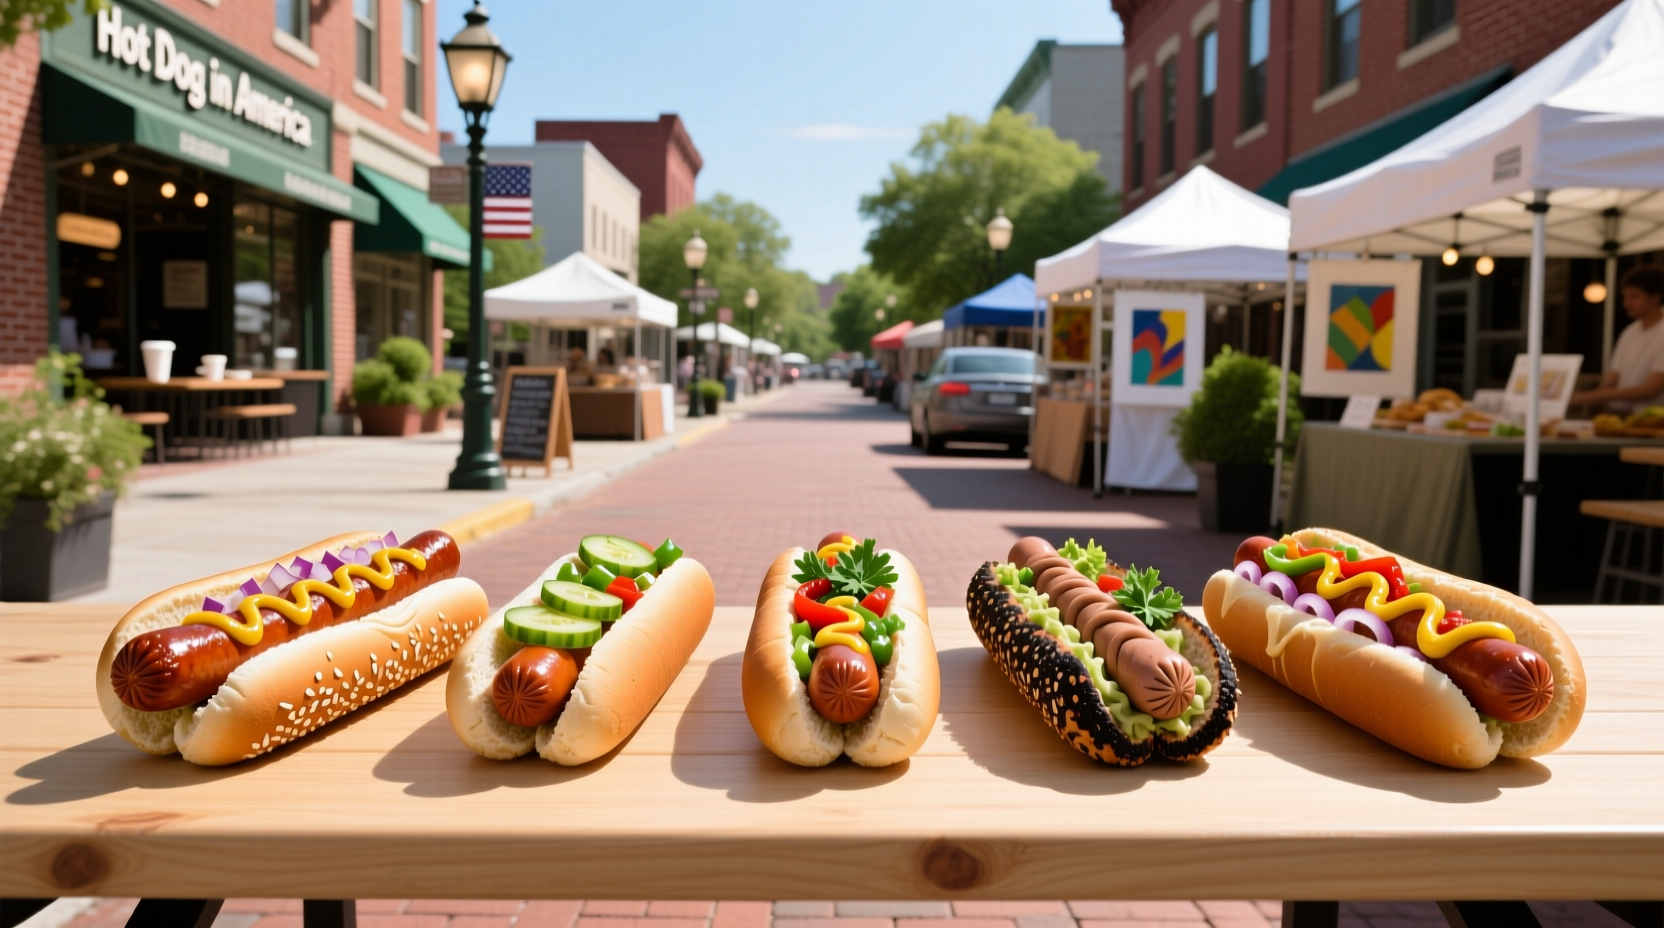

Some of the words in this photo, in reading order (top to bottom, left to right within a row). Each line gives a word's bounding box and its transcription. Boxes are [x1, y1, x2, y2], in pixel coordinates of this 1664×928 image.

[97, 6, 151, 72] Hot
[154, 27, 206, 110] Dog
[209, 57, 233, 111] in
[233, 71, 312, 147] America
